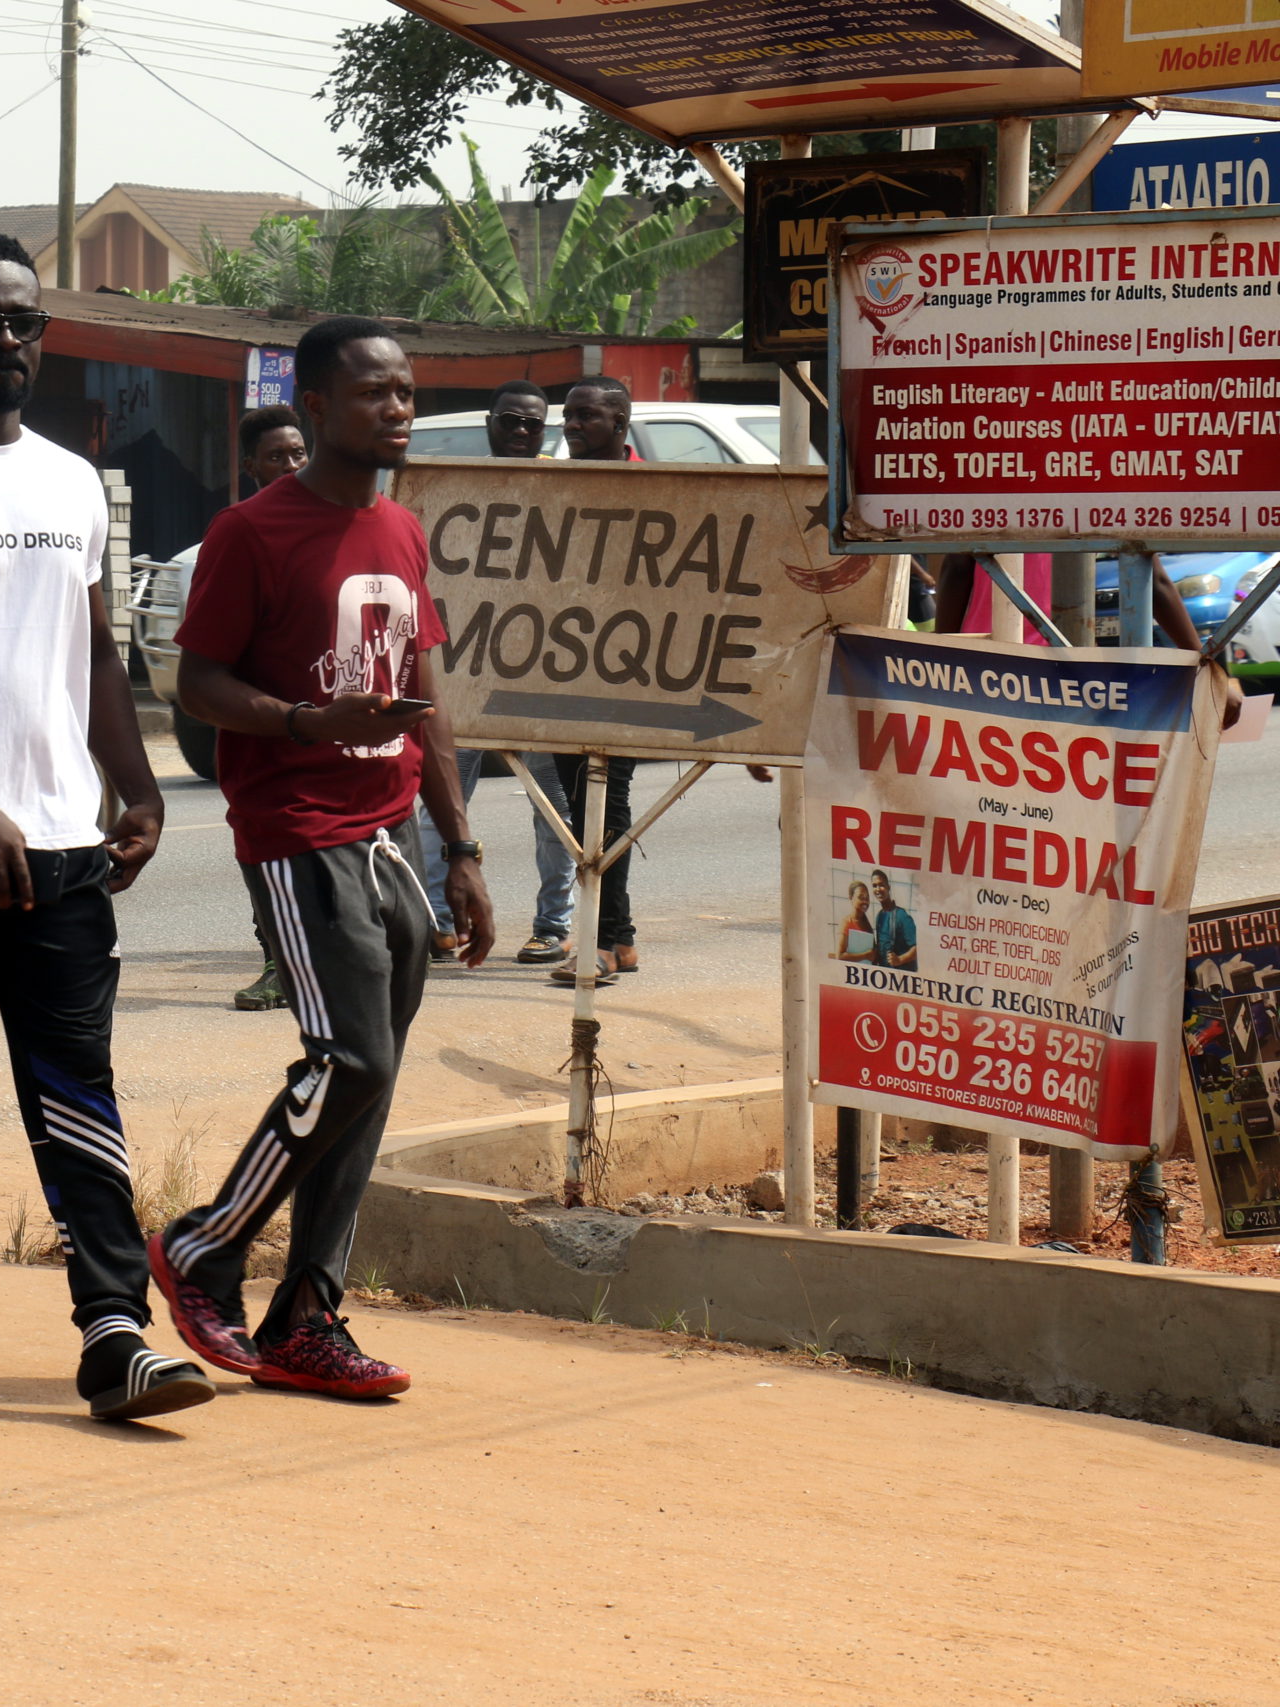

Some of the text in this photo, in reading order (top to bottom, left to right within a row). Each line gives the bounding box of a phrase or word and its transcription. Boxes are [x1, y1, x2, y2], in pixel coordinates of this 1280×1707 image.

[526, 33, 594, 44] TUESDAY
[670, 18, 720, 30] BIBLE
[715, 4, 809, 23] TEACHINGS
[546, 42, 627, 55] WEDNESDAY
[744, 14, 830, 31] FELLOWSHIP
[565, 52, 640, 65] THURSDAY
[717, 34, 772, 47] PRAYER
[769, 25, 835, 40] TOWERS
[597, 29, 980, 78] ALL NIGHT SERVICE ON EVERY FRIDAY
[1158, 41, 1242, 73] Mobile
[636, 72, 708, 84] SATURDAY
[702, 63, 773, 76] EVENING
[829, 48, 903, 62] PRACTICE
[644, 81, 718, 94] SUNDAY
[731, 70, 811, 86] CHURCH
[806, 61, 887, 77] SERVICE
[1128, 157, 1270, 211] ATAAFIO
[918, 241, 1280, 288] SPEAKWRITE INTERN
[923, 281, 1271, 309] Language Programmes for Adults, Students and
[872, 324, 1280, 359] French Spanish Chinese English Ger
[260, 394, 281, 405] HERE
[261, 383, 282, 394] SOLD
[872, 383, 943, 410] English
[950, 382, 1030, 408] Literacy
[1051, 380, 1104, 402] Adult
[875, 416, 966, 441] Aviation
[973, 415, 1063, 440] Courses
[1070, 413, 1128, 443] (IATA
[874, 449, 1243, 483] IELTS, TOFEL, GRE, GMAT, SAT
[928, 508, 965, 529] 030
[971, 508, 1008, 529] 393
[1016, 507, 1064, 529] 1376
[1089, 506, 1127, 528] 024
[1134, 507, 1172, 527] 326
[1180, 506, 1231, 527] 9254
[23, 532, 83, 552] DRUGS
[429, 502, 763, 597] CENTRAL
[310, 589, 419, 694] Original
[430, 597, 763, 696] MOSQUE
[884, 655, 1129, 712] NOWA COLLEGE
[856, 708, 1161, 808] WASSCE
[978, 796, 1009, 817] (May
[1020, 801, 1054, 823] June)
[830, 804, 1156, 906] REMEDIAL
[976, 888, 1009, 906] (Nov
[1021, 894, 1050, 915] Dec)
[928, 911, 1070, 947] ENGLISH PROFICIECIENCY
[1187, 909, 1280, 958] BIO TECH
[939, 933, 1061, 967] SAT, GRE, TOEFL, DBS
[947, 957, 1053, 987] ADULT EDUCATION
[1085, 982, 1097, 999] is
[1097, 973, 1114, 993] our
[844, 965, 1126, 1037] BIOMETRIC REGISTRATION
[896, 1002, 1106, 1072] 055 235 5257
[290, 1063, 324, 1106] NIKE
[895, 1040, 1100, 1113] 050 236 6405
[876, 1074, 933, 1096] OPPOSITE
[935, 1086, 977, 1106] STORES
[978, 1094, 1024, 1118] BUSTOP,
[1026, 1104, 1083, 1131] KWABENYA,
